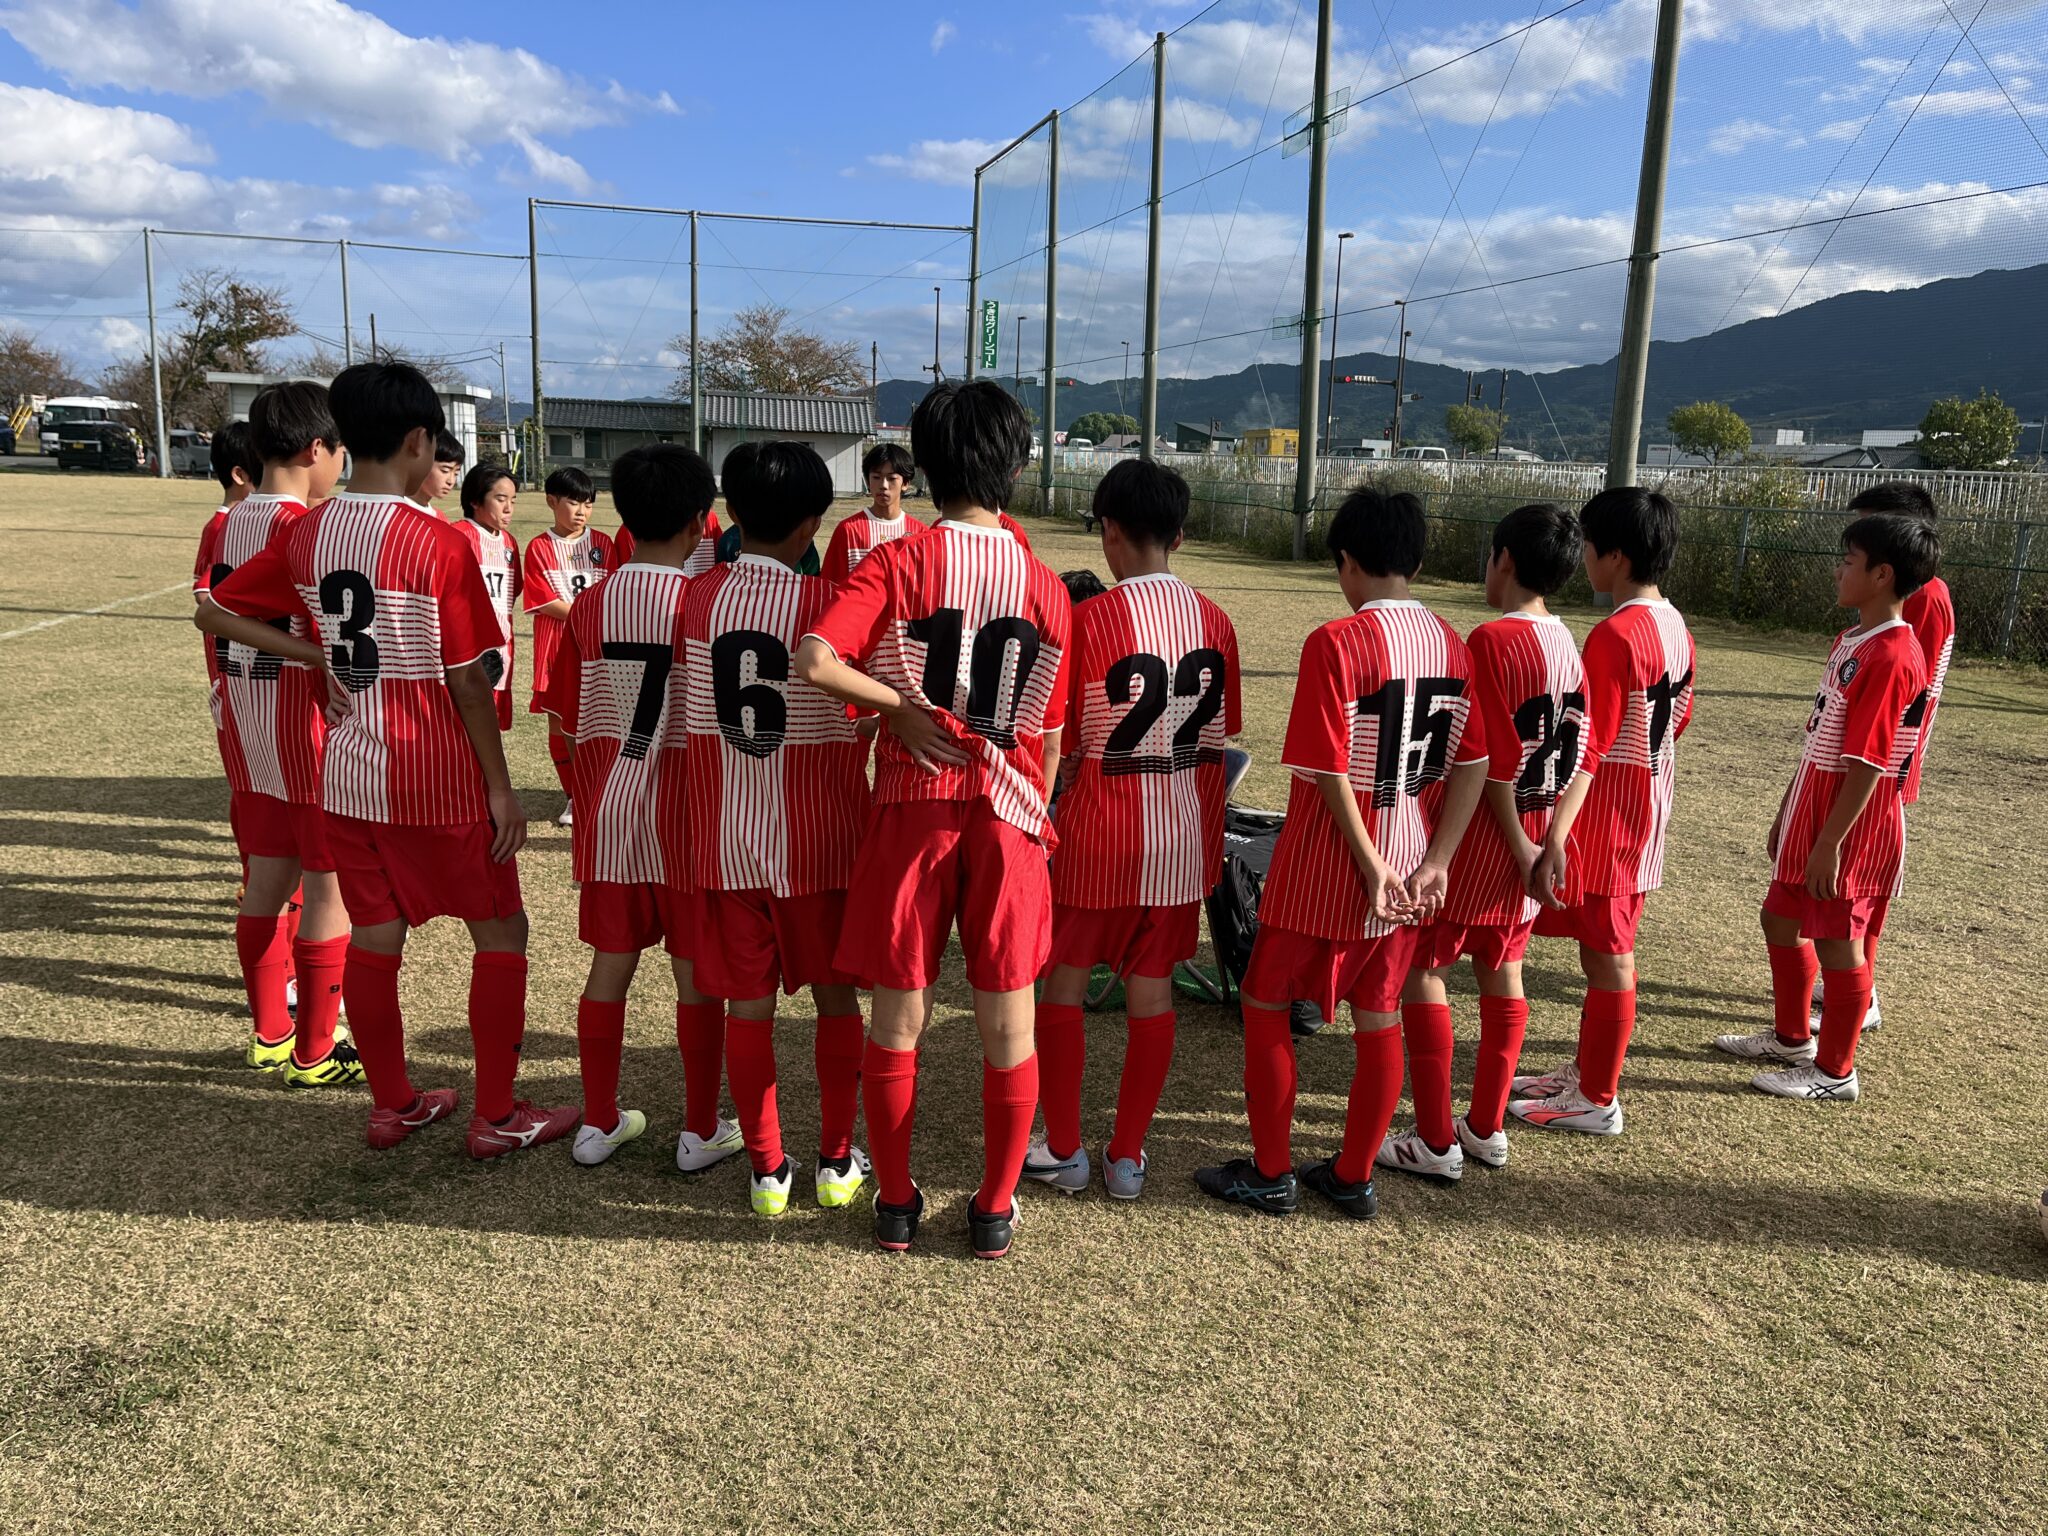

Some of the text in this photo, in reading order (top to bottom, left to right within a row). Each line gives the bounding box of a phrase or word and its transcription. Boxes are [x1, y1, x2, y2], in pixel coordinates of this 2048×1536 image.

[319, 570, 379, 693] 3
[486, 572, 504, 598] 17
[571, 575, 586, 597] 8
[602, 642, 673, 760] 7
[711, 629, 789, 759] 6
[906, 608, 1040, 749] 10
[1102, 648, 1225, 776] 22
[1358, 677, 1465, 810] 15
